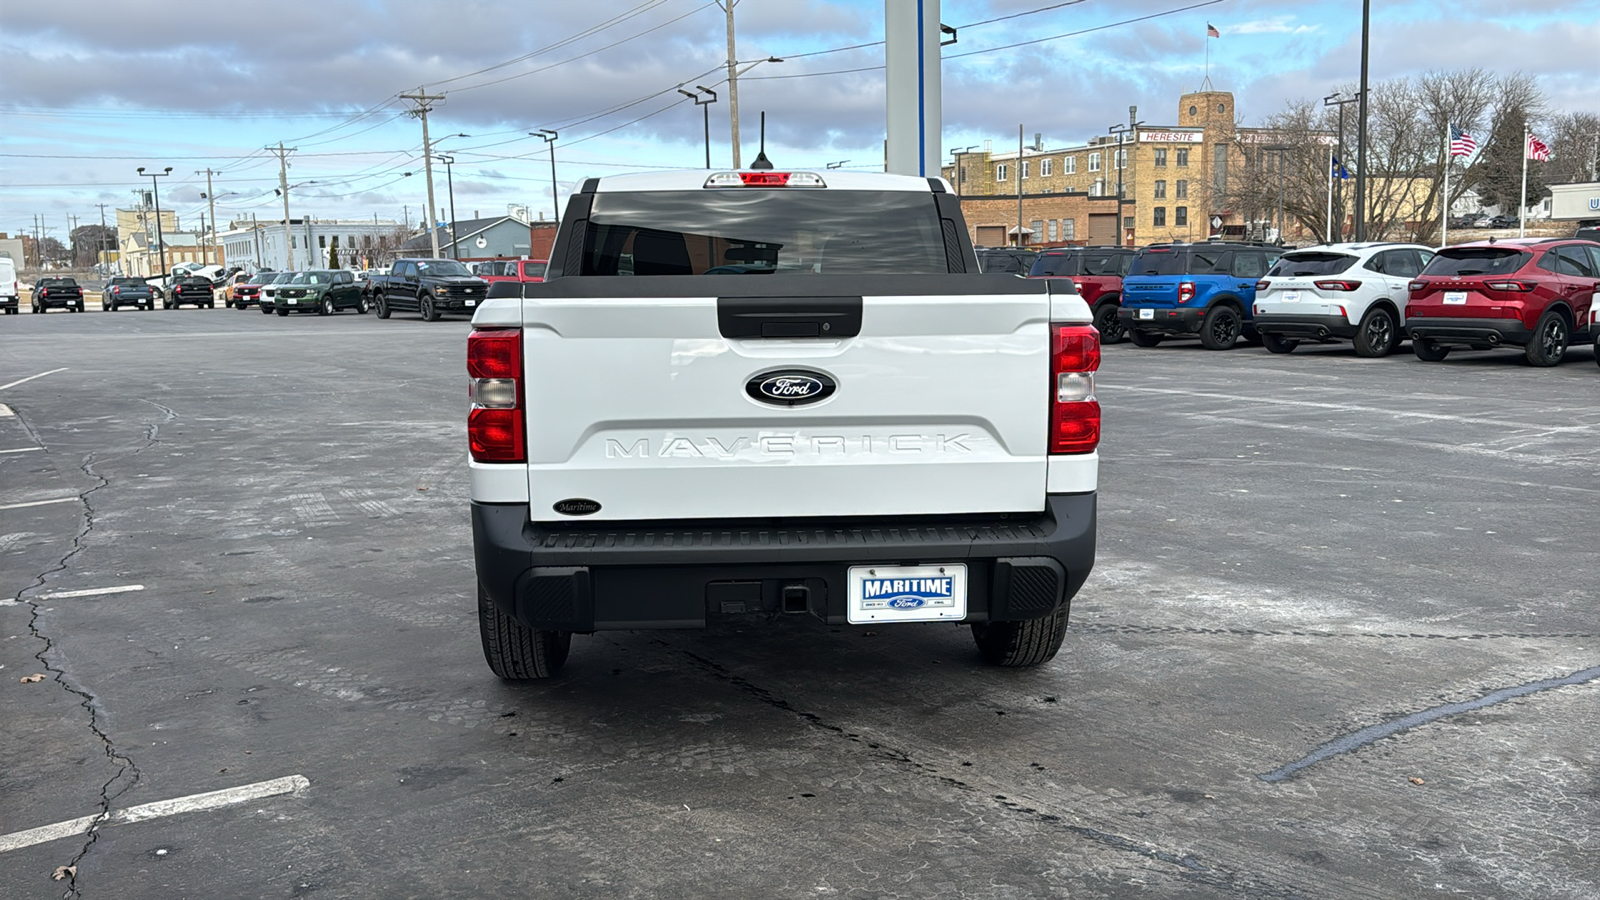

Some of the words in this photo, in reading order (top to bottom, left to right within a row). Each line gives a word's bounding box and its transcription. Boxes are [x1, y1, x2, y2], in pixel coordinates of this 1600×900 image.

[1146, 132, 1194, 141] HERESITE
[772, 378, 811, 395] Ford
[605, 433, 973, 459] MAVERICK
[560, 503, 597, 512] Maritime
[865, 578, 951, 598] MARITIME
[894, 598, 919, 608] Ford
